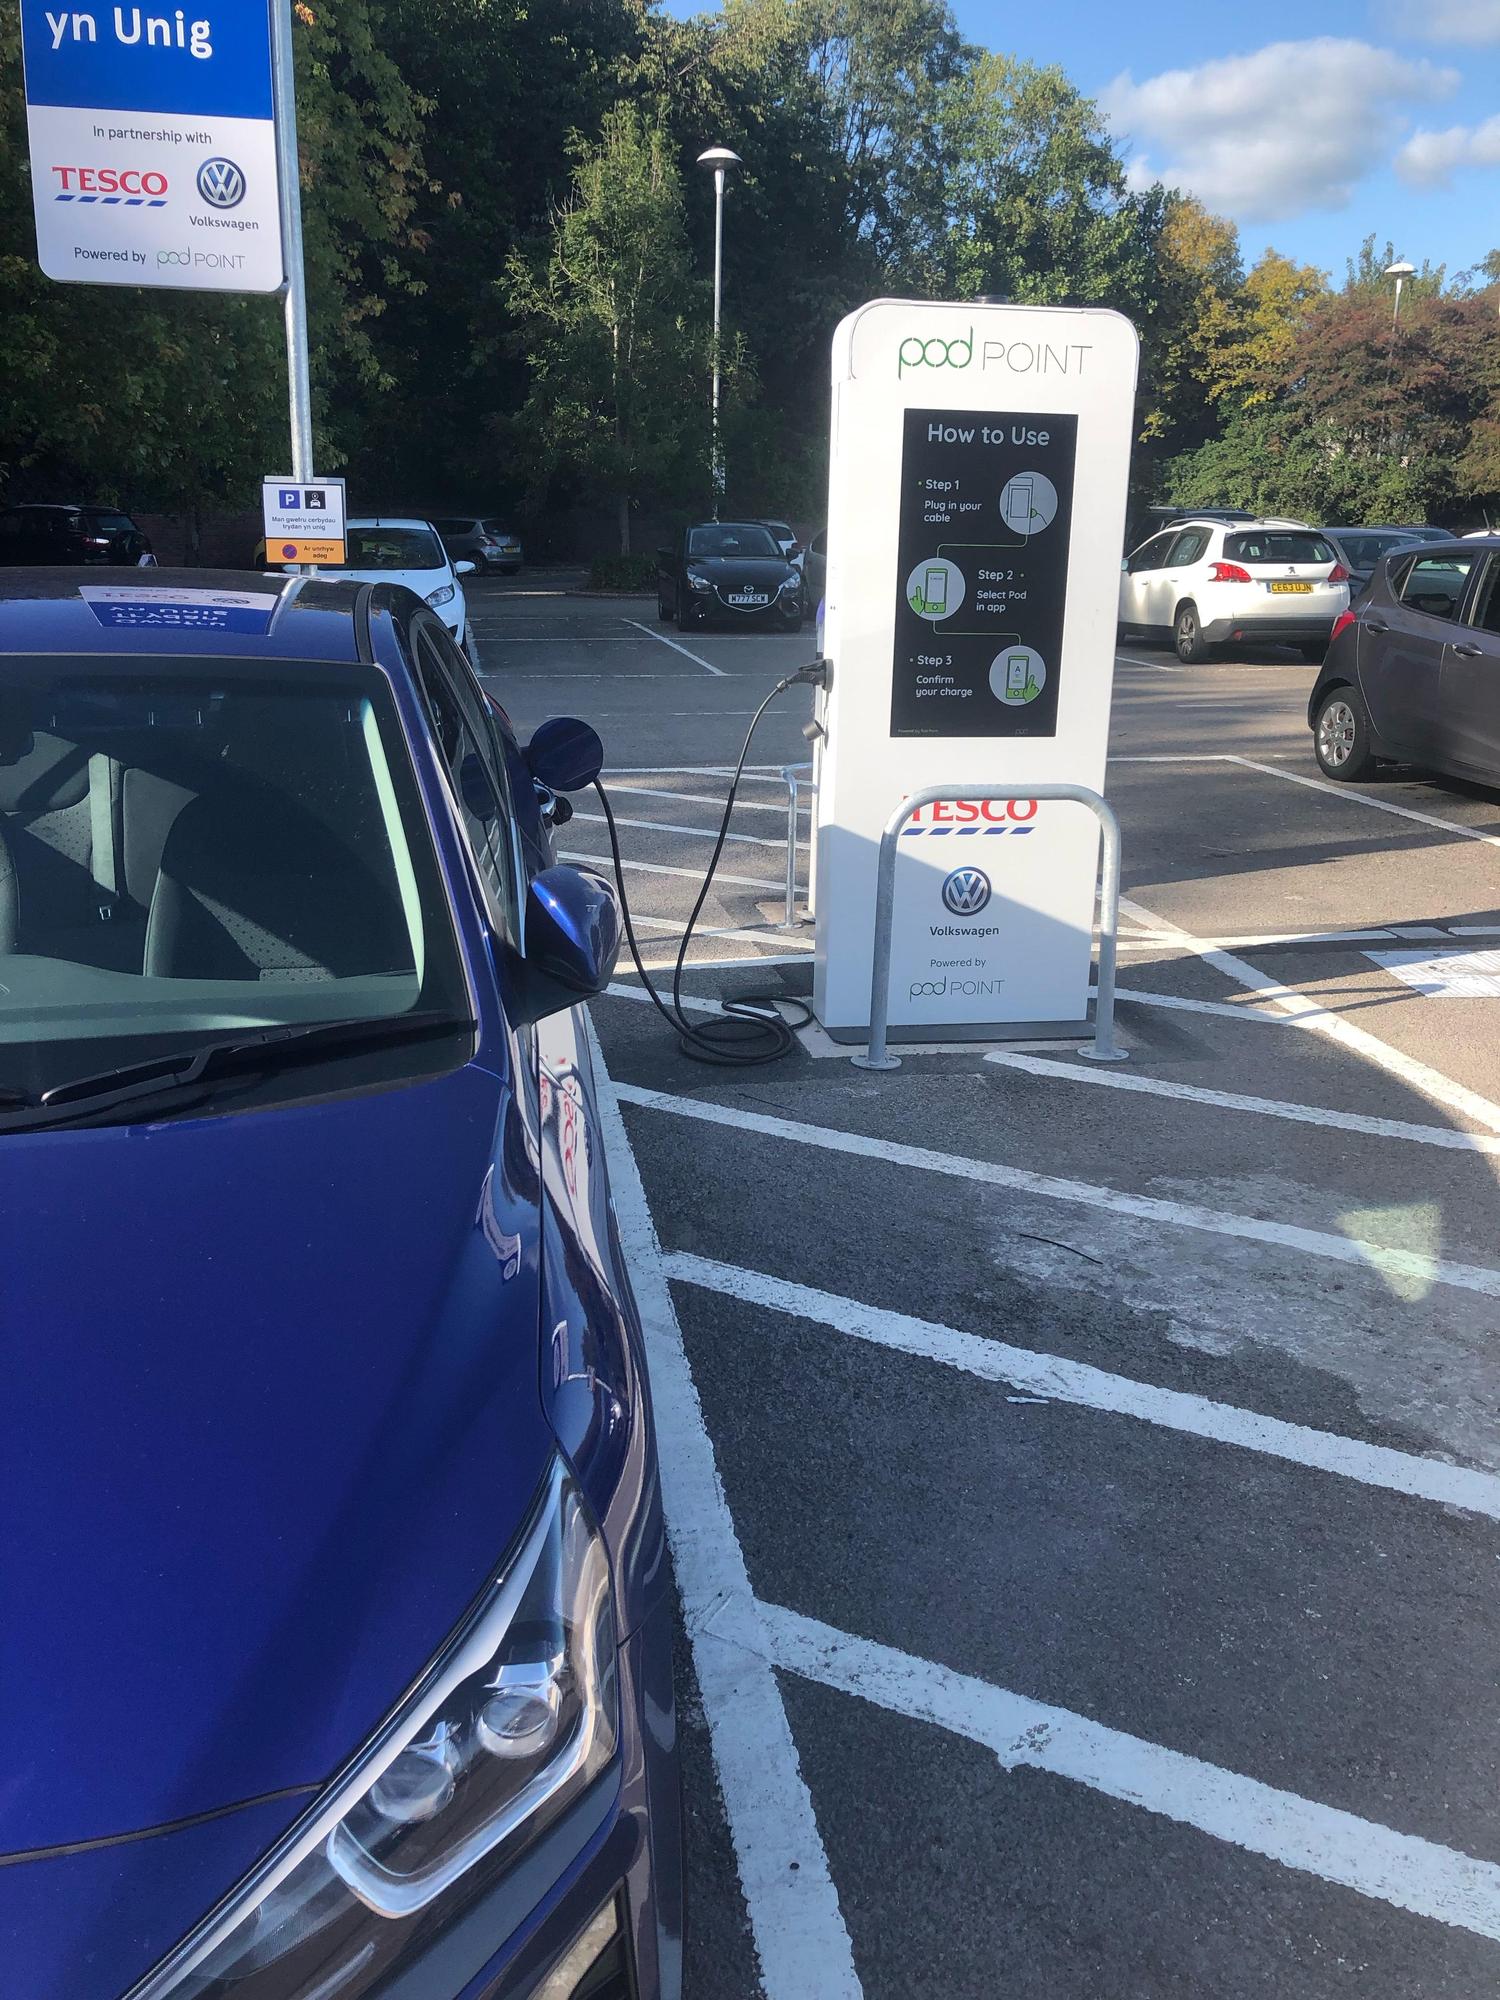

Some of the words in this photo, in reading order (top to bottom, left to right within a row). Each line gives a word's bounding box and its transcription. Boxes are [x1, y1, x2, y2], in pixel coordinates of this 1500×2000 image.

[45, 12, 97, 49] yn
[113, 7, 213, 59] Unig
[93, 125, 105, 138] In
[108, 126, 182, 144] partnership
[185, 131, 212, 144] with
[52, 166, 168, 196] TESCO
[189, 215, 259, 231] Volkswagen
[74, 247, 129, 262] Powered
[132, 250, 146, 265] by
[156, 246, 191, 270] pod
[194, 252, 246, 269] POINT
[899, 326, 973, 380] pod
[983, 341, 1093, 375] POINT
[927, 423, 975, 444] How
[982, 426, 1004, 445] to
[1011, 426, 1050, 446] Use
[925, 479, 952, 493] Step
[954, 479, 960, 490] 1
[285, 494, 295, 506] P
[924, 500, 945, 513] Plug
[948, 500, 957, 511] in
[959, 503, 982, 513] your
[924, 512, 951, 523] cable
[978, 570, 1004, 582] Step
[1006, 570, 1014, 580] 2
[977, 590, 1006, 600] Select
[1008, 590, 1027, 600] Pod
[976, 602, 985, 612] in
[987, 603, 1006, 614] app
[917, 655, 943, 667] Step
[945, 655, 953, 665] 3
[916, 675, 954, 685] Confirm
[915, 689, 938, 699] your
[940, 687, 973, 698] charge
[929, 926, 1000, 938] Volkswagen
[930, 959, 972, 968] Powered
[975, 958, 987, 969] by
[909, 976, 947, 1003] pod
[950, 980, 1006, 996] POINT
